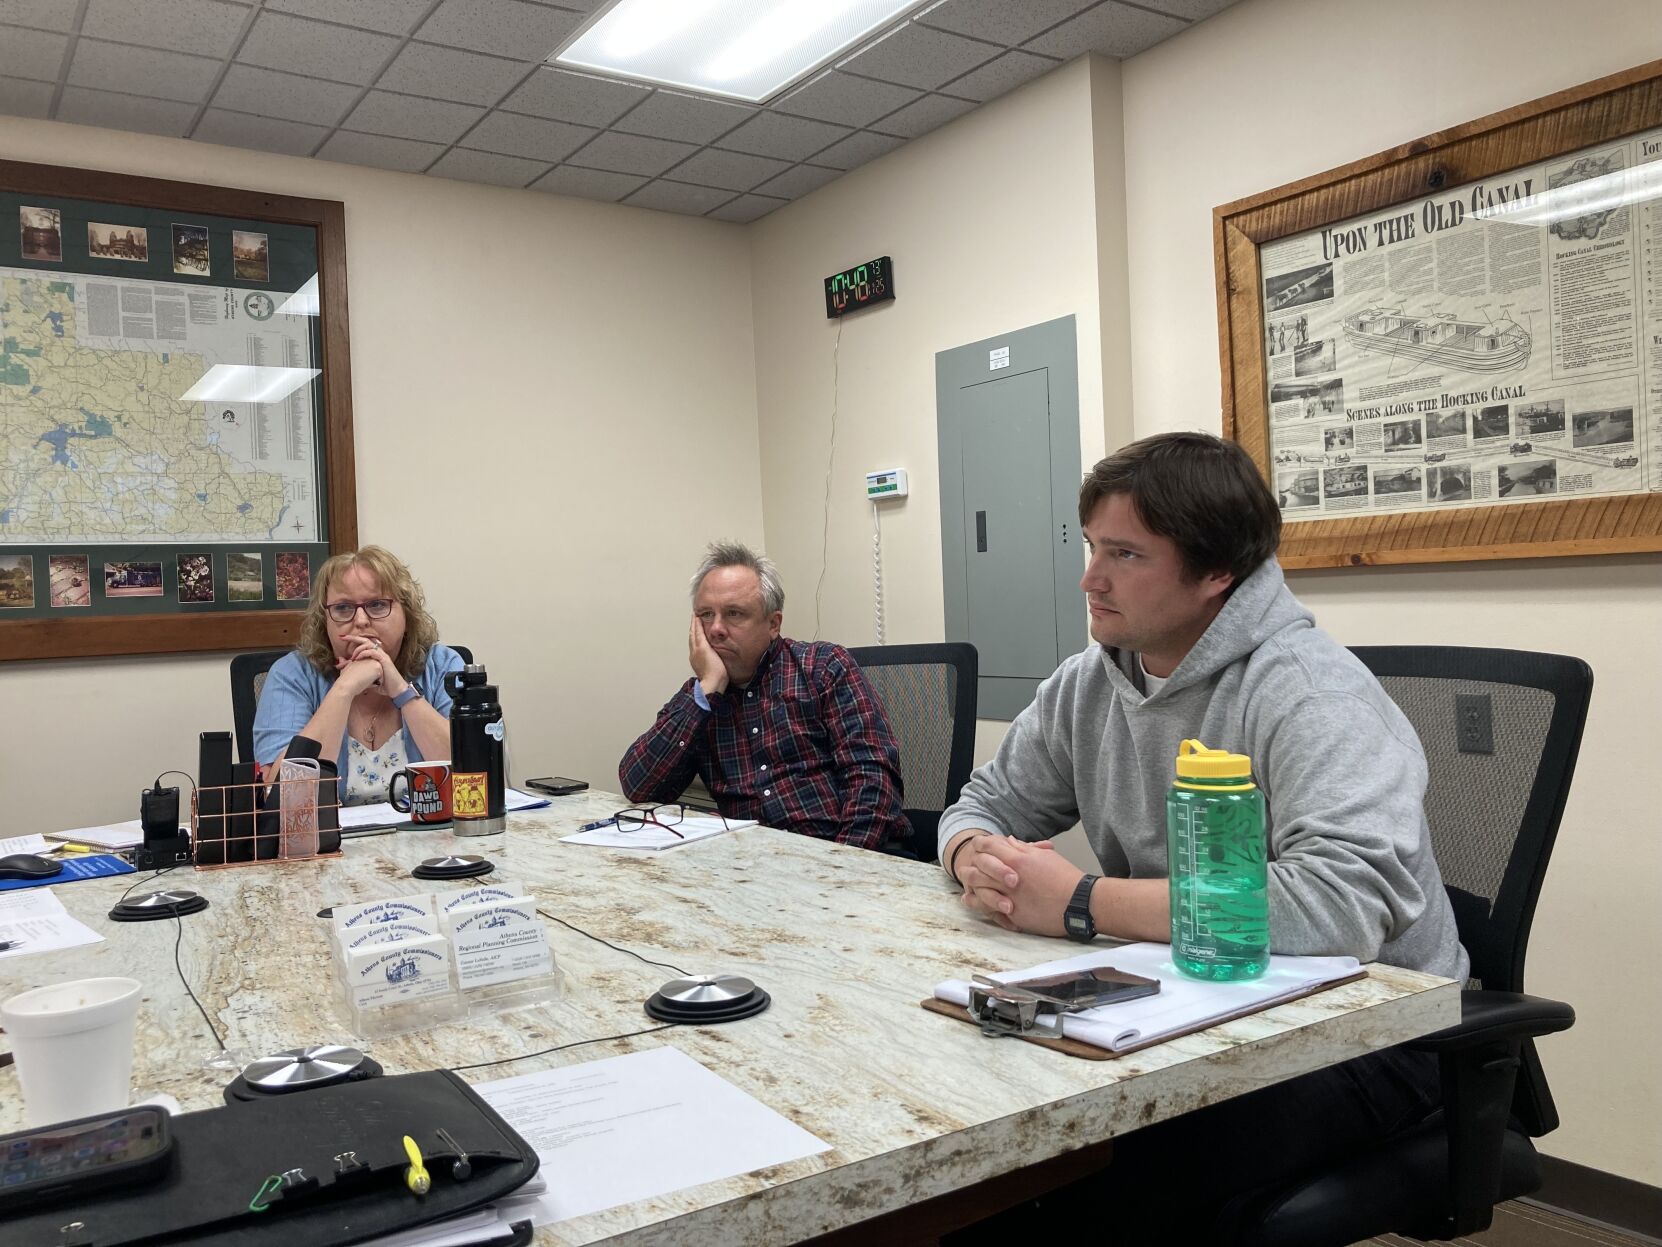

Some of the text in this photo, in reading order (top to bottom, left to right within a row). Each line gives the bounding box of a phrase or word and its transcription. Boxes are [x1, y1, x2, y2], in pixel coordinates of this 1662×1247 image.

[1321, 226, 1368, 260] UPON
[1374, 212, 1416, 247] THE
[1422, 199, 1464, 234] OLD
[1471, 179, 1539, 220] CANAL
[1346, 385, 1526, 422] SCENES ALONG THE HOCKING CANAL
[412, 800, 443, 814] POUND
[414, 791, 439, 802] DAWG
[461, 890, 479, 900] County
[344, 902, 426, 928] Athens County Commissioners
[456, 908, 530, 932] Athens County Commissioners
[368, 927, 388, 937] County
[459, 934, 538, 952] Regional Planning Commission
[360, 948, 442, 976] Athens County Commissioners
